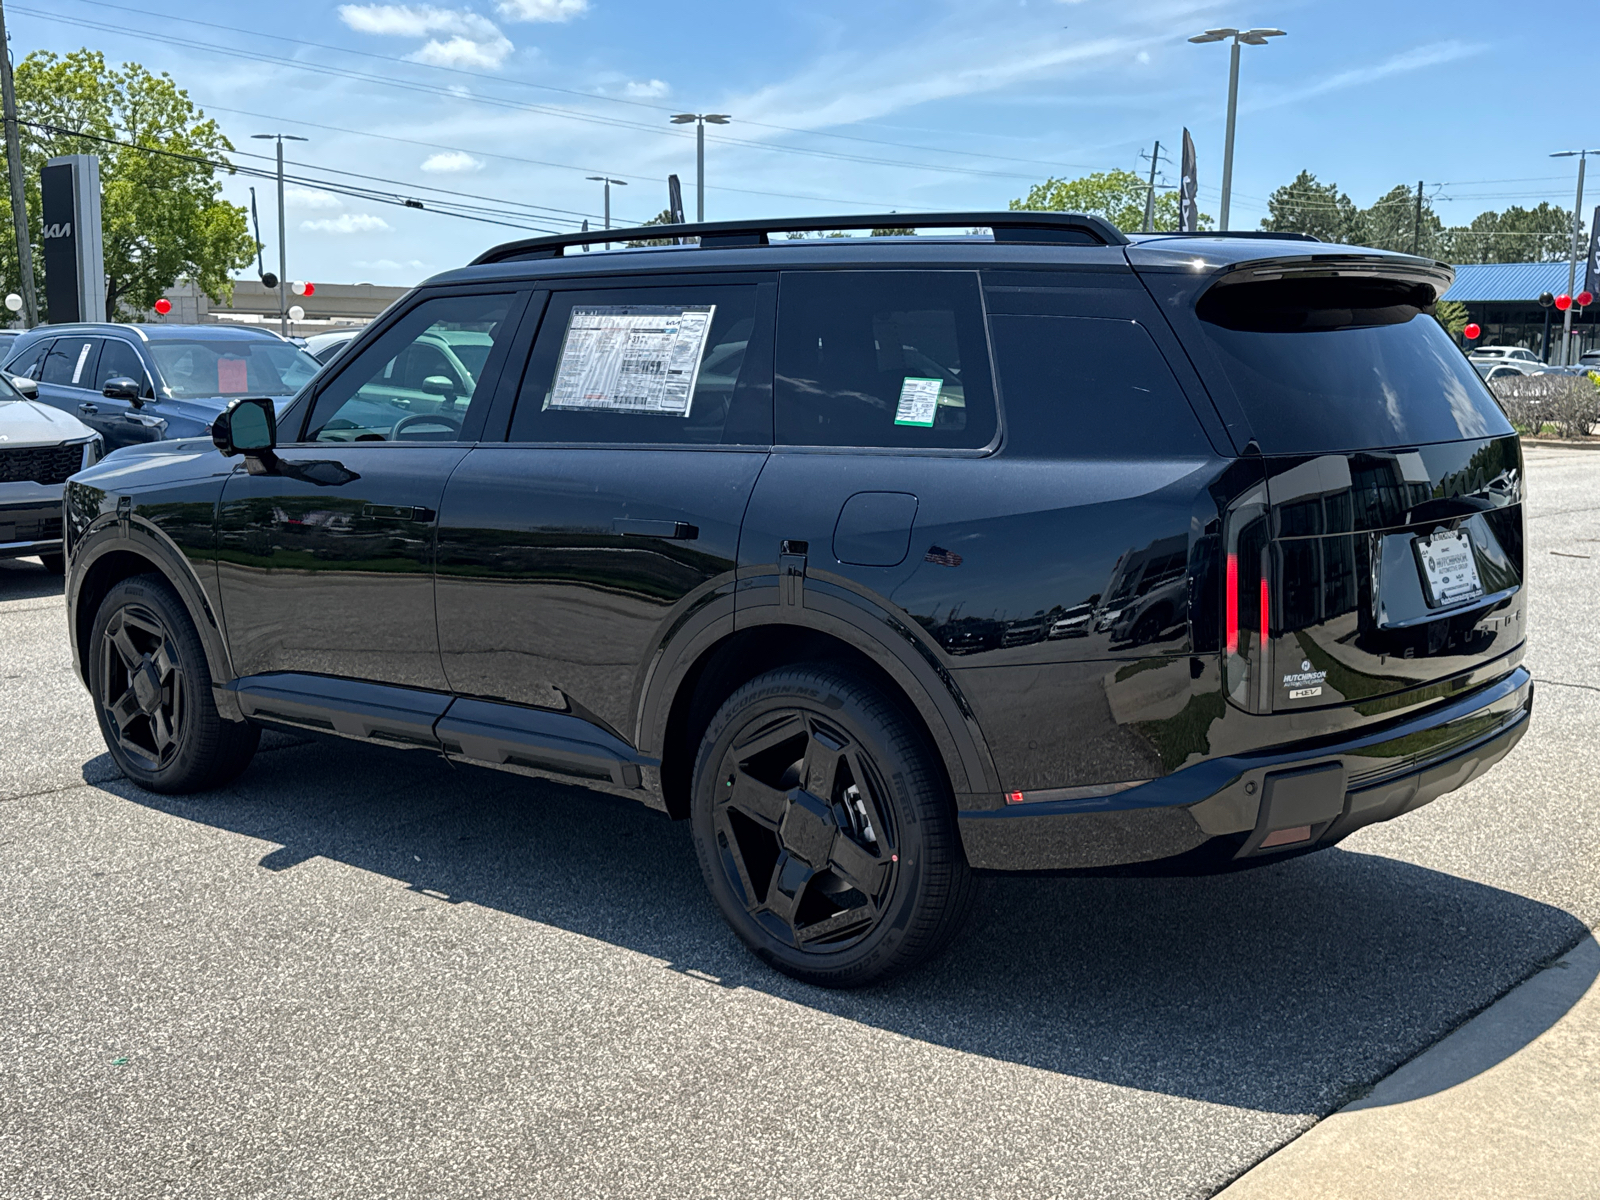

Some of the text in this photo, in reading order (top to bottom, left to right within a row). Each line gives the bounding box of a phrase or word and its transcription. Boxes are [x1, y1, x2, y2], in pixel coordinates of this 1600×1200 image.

[43, 222, 71, 239] KIA
[1443, 466, 1486, 499] KIA
[1377, 609, 1521, 666] TELLURIDE
[1283, 671, 1327, 682] HUTCHINSON
[724, 685, 792, 721] SCORPION
[1296, 689, 1318, 697] HEV
